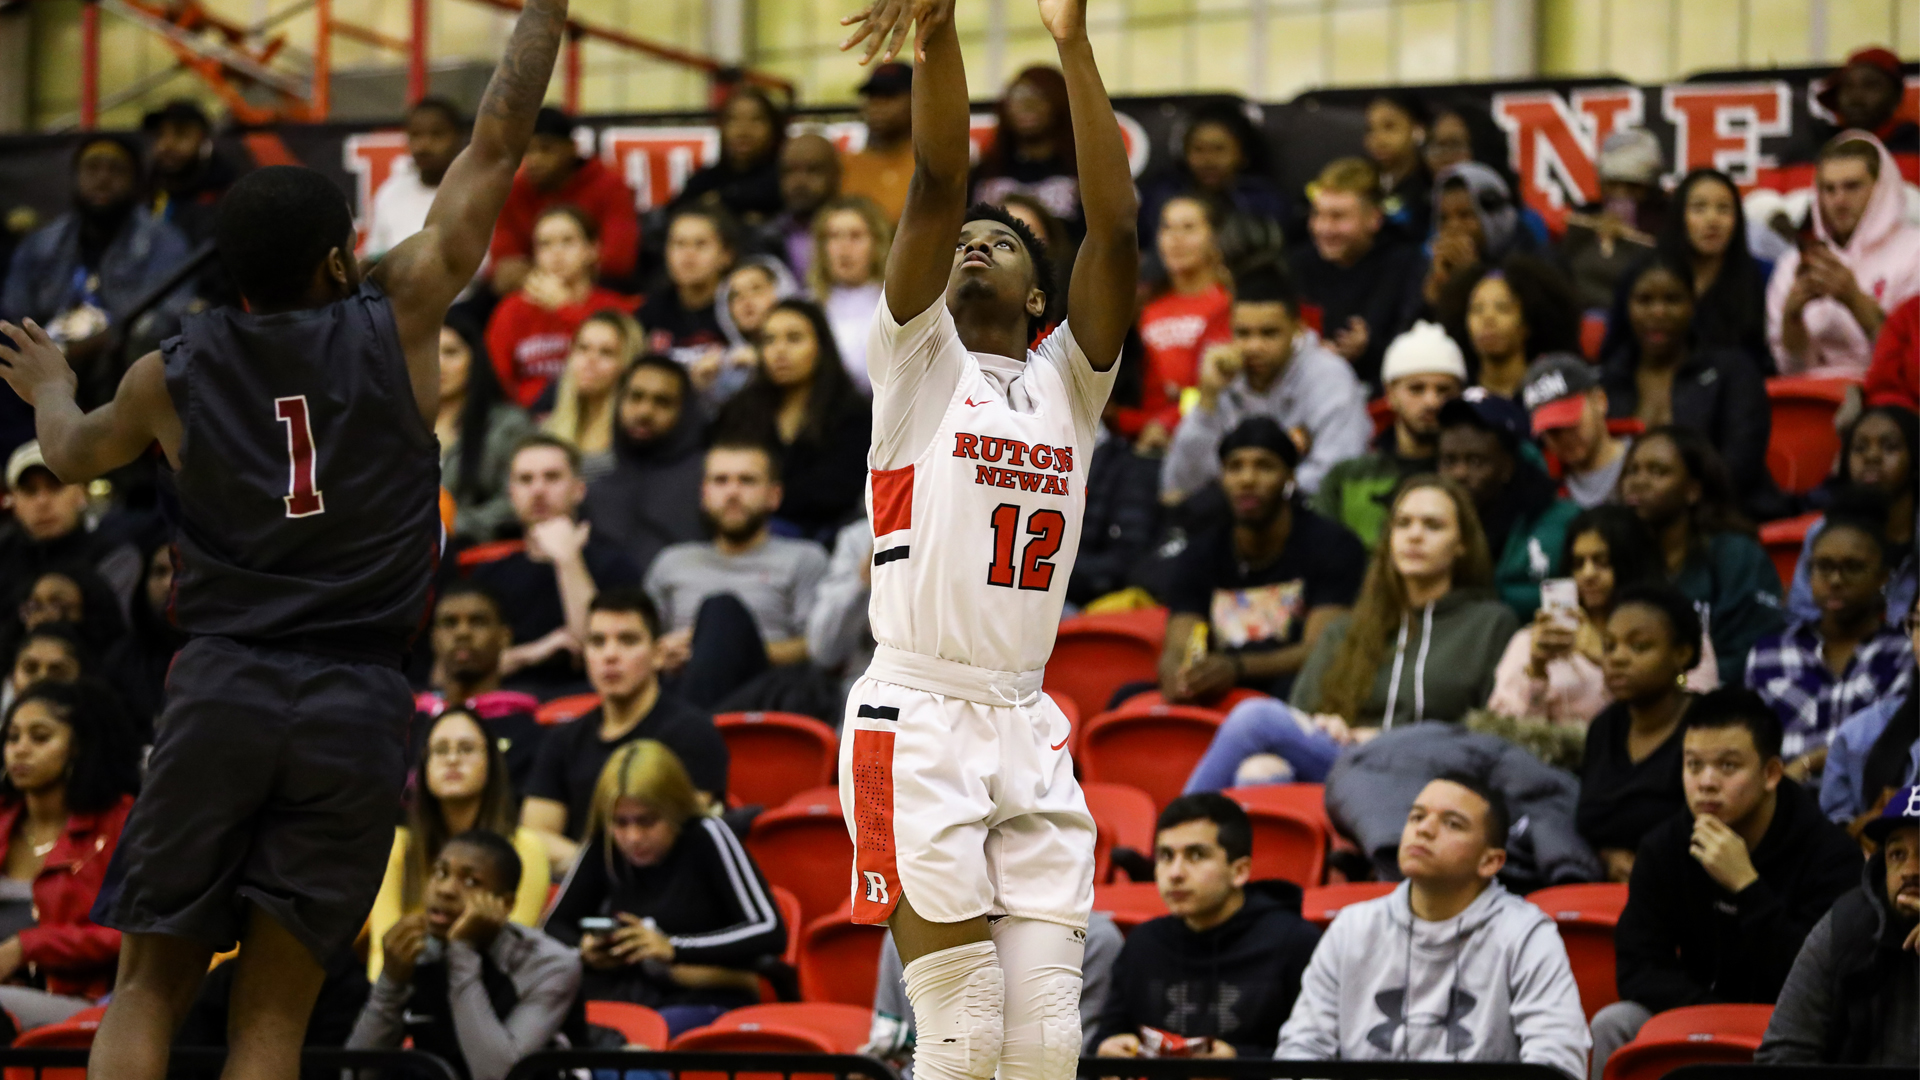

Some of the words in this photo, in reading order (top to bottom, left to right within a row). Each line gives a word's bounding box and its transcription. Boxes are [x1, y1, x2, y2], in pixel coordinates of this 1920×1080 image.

[264, 394, 325, 518] 1
[952, 432, 1073, 473] RUTGS
[975, 464, 1069, 496] NEWA
[987, 502, 1066, 592] 12
[863, 869, 889, 904] R
